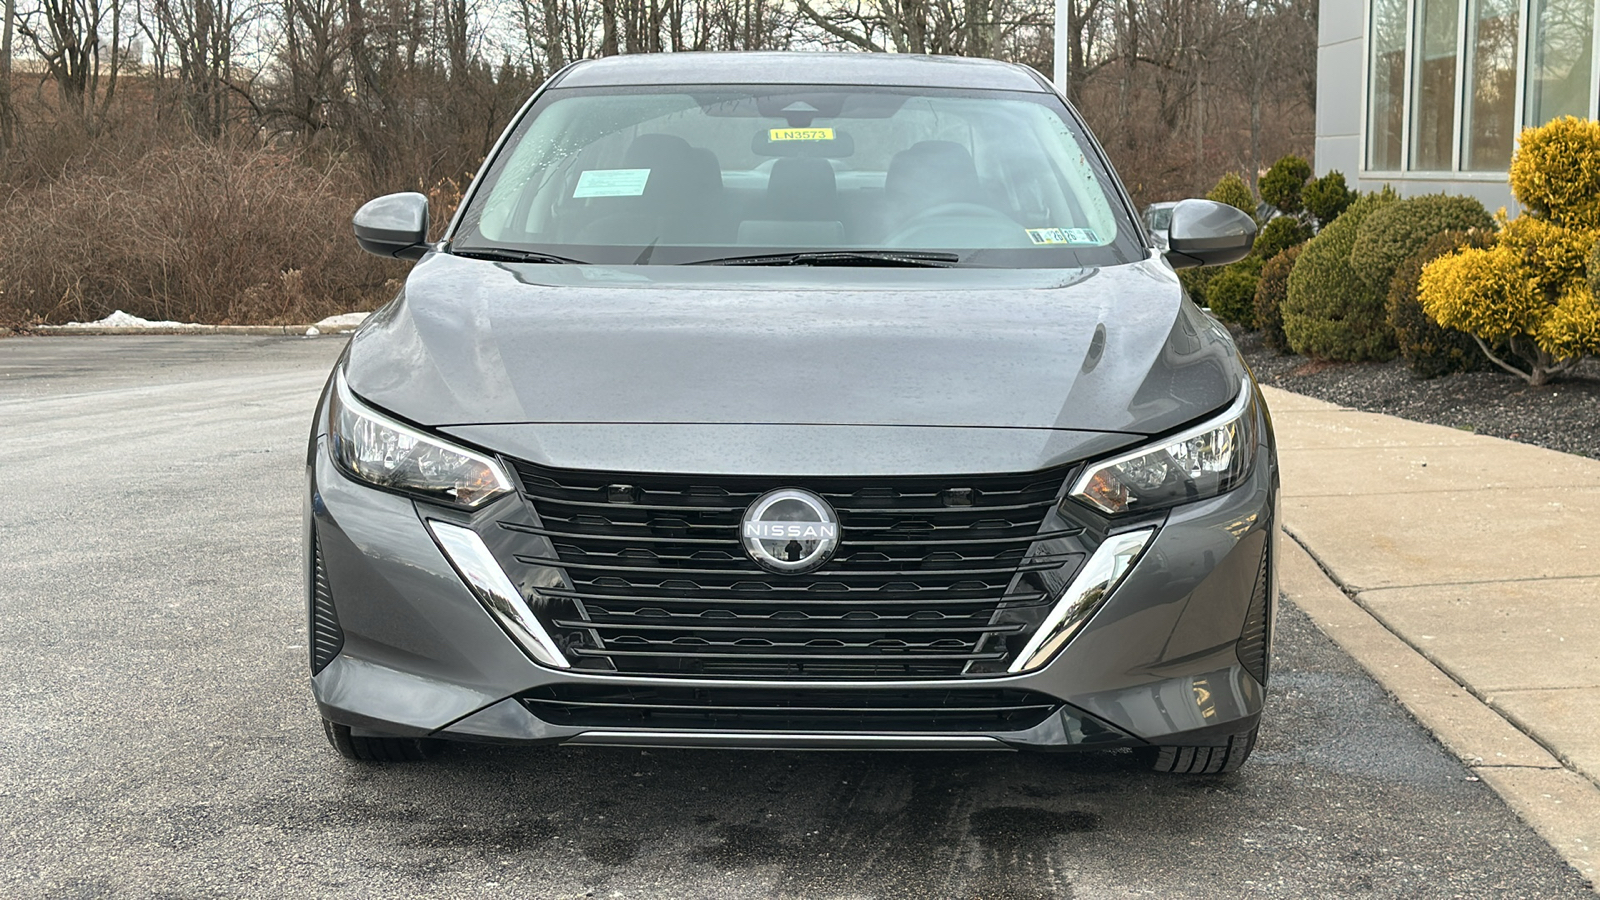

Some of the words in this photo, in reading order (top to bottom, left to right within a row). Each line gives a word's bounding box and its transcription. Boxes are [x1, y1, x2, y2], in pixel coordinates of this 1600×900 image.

[775, 131, 826, 139] LN3573
[1051, 230, 1064, 241] 26
[1064, 230, 1077, 241] 26
[747, 524, 834, 537] NISSAN
